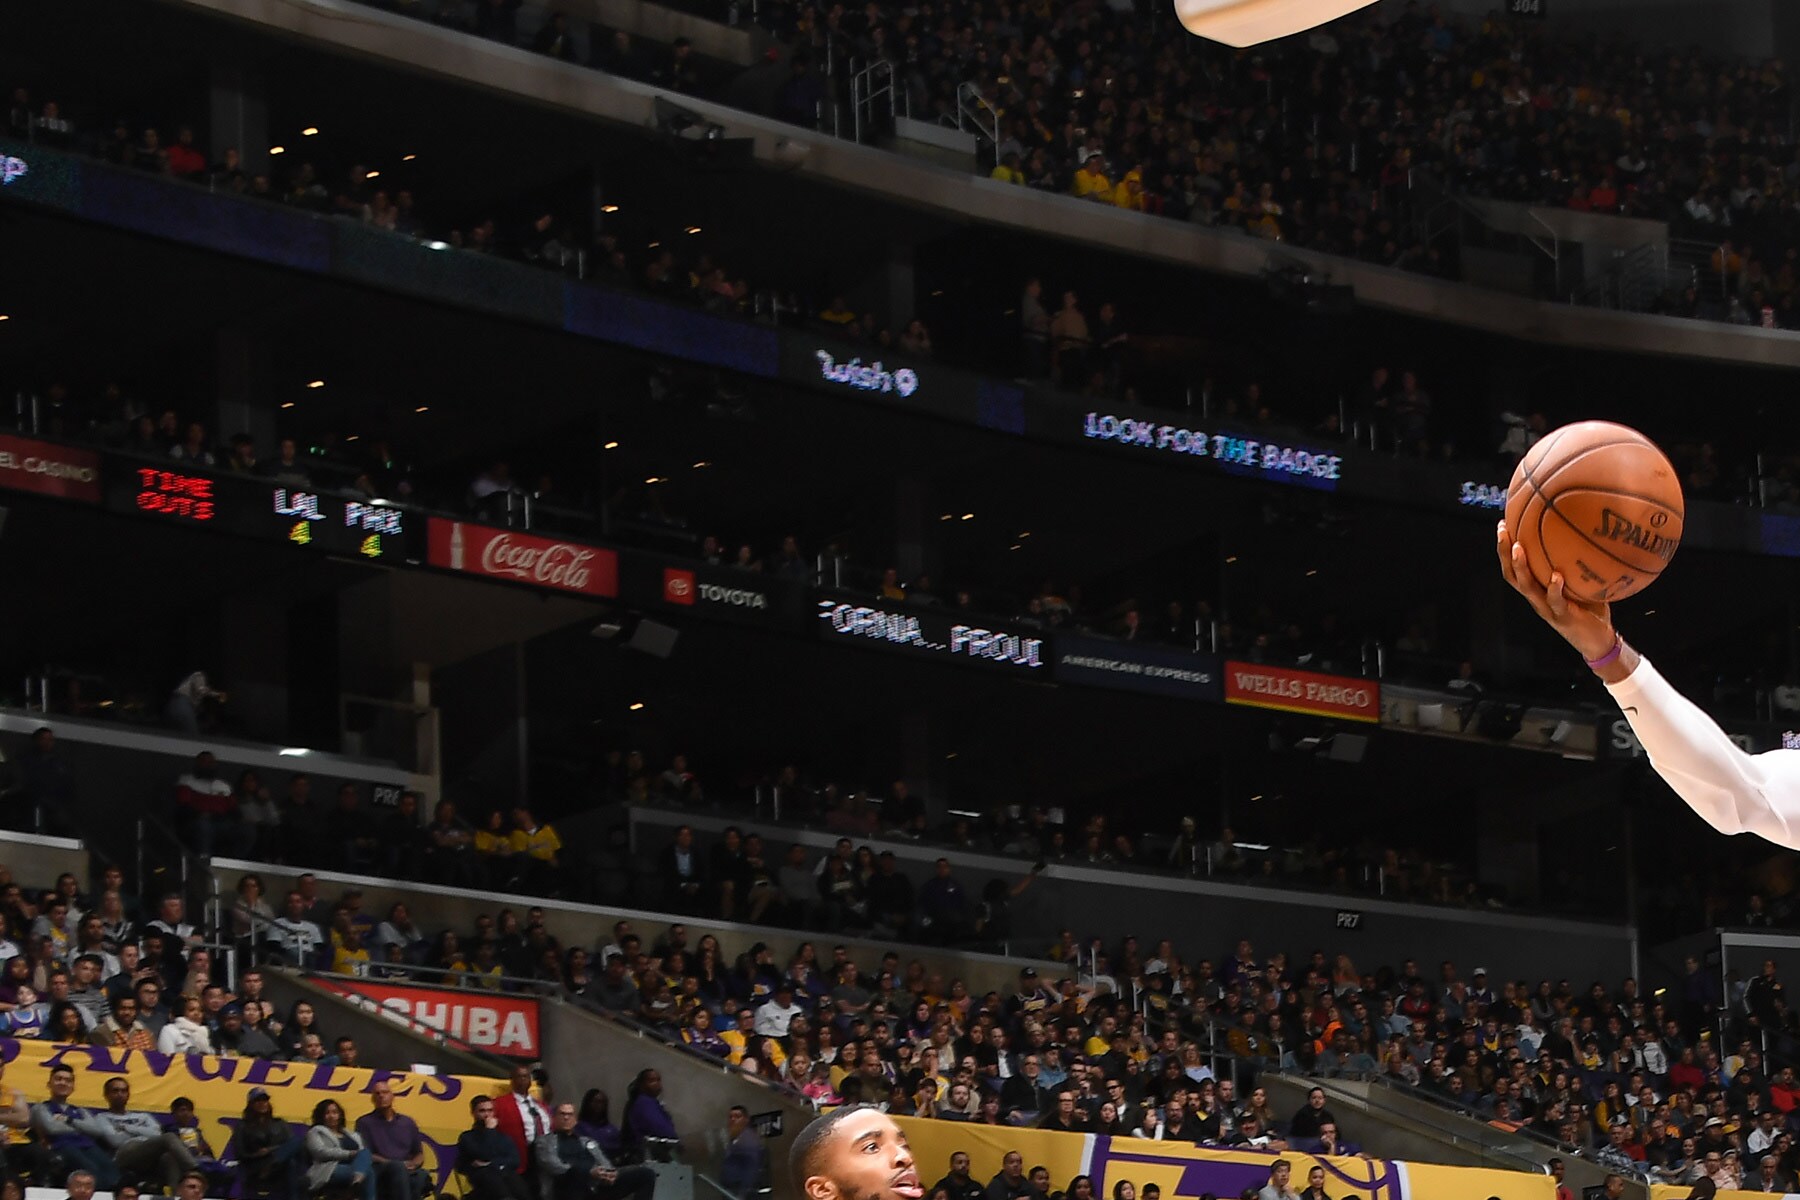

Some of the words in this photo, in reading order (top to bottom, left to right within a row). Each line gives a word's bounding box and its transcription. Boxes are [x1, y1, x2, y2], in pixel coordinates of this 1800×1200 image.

[815, 349, 895, 393] wish
[1084, 411, 1155, 449] LOOK
[1156, 424, 1209, 456] FOR
[1212, 432, 1259, 467] THE
[1260, 444, 1343, 480] BADGE
[136, 466, 215, 499] TIME
[136, 490, 216, 521] OUTS
[272, 487, 328, 521] LAL
[344, 500, 404, 536] PHX
[288, 519, 312, 545] 4
[359, 532, 384, 558] 4
[481, 532, 596, 590] Coca-Cola
[698, 583, 768, 610] TOYOTA
[1061, 653, 1143, 676] AMERICAN
[1143, 664, 1212, 684] EXPRESS
[1234, 672, 1303, 700] WELLS
[1304, 682, 1371, 708] FARGO
[1336, 912, 1360, 928] PR7
